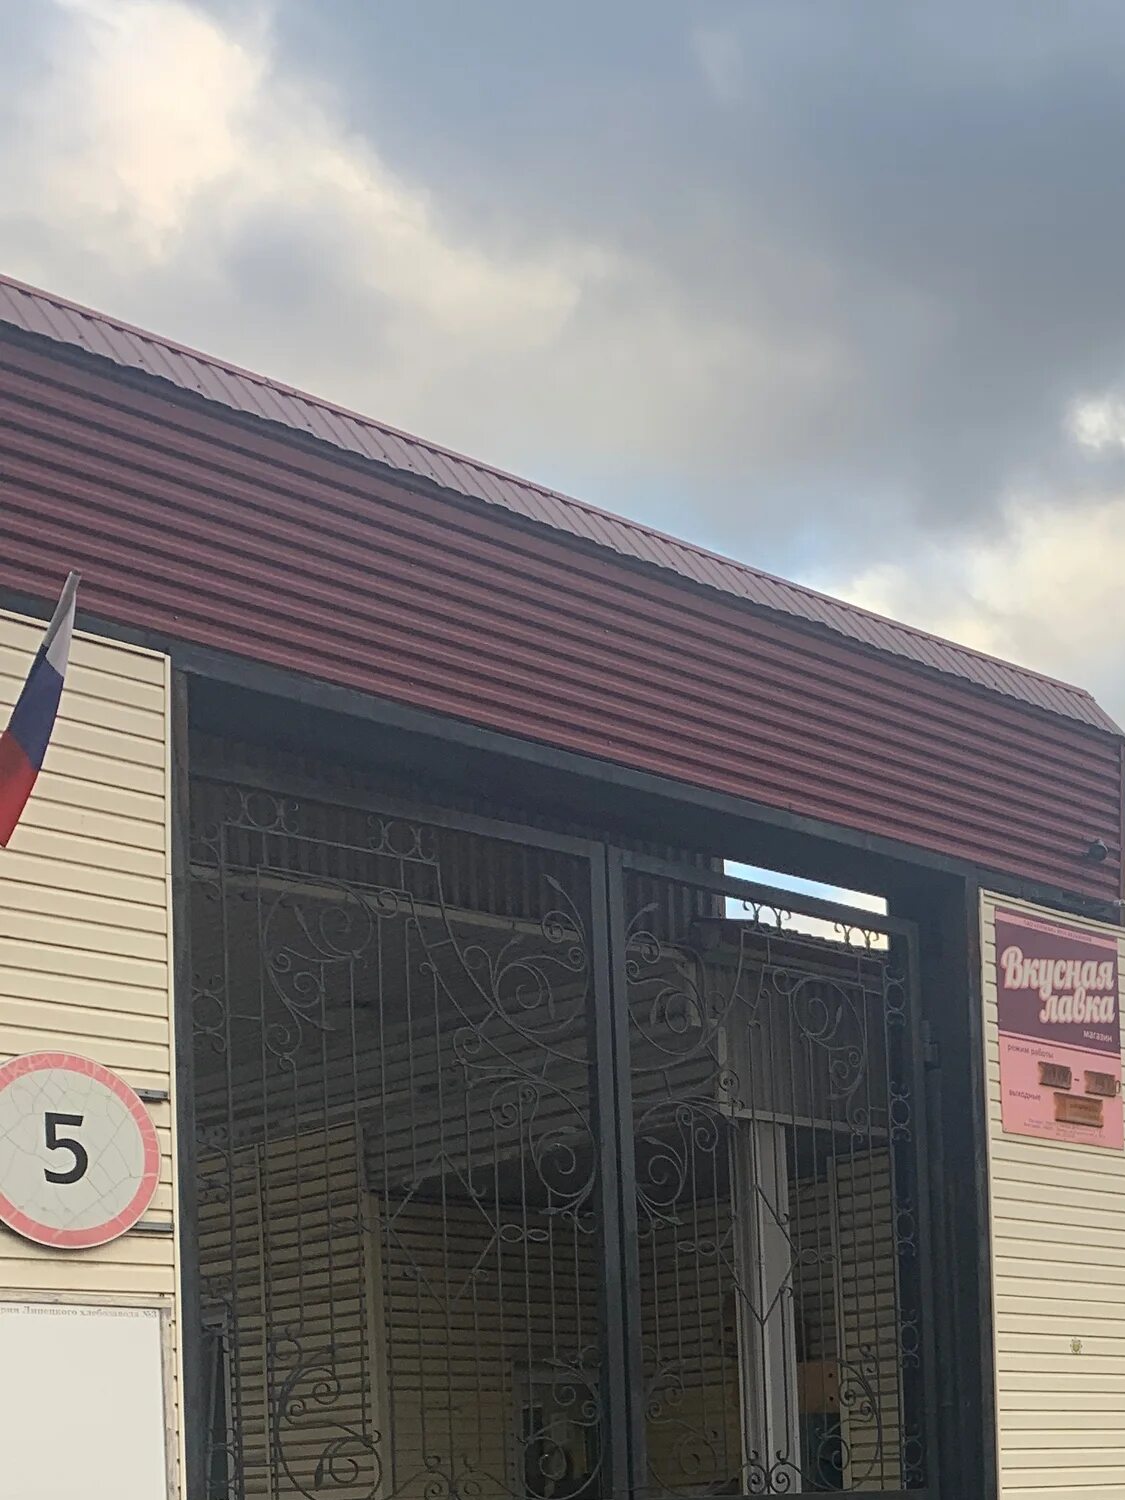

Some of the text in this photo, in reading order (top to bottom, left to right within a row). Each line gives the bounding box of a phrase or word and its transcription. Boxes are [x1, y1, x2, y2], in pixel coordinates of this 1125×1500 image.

[1001, 945, 1115, 1001] Вкусная
[1039, 986, 1116, 1024] лавка
[1083, 1029, 1113, 1043] магазин
[44, 1111, 89, 1185] 5
[22, 1305, 78, 1317] Липецкого
[80, 1308, 140, 1319] хлебозавода
